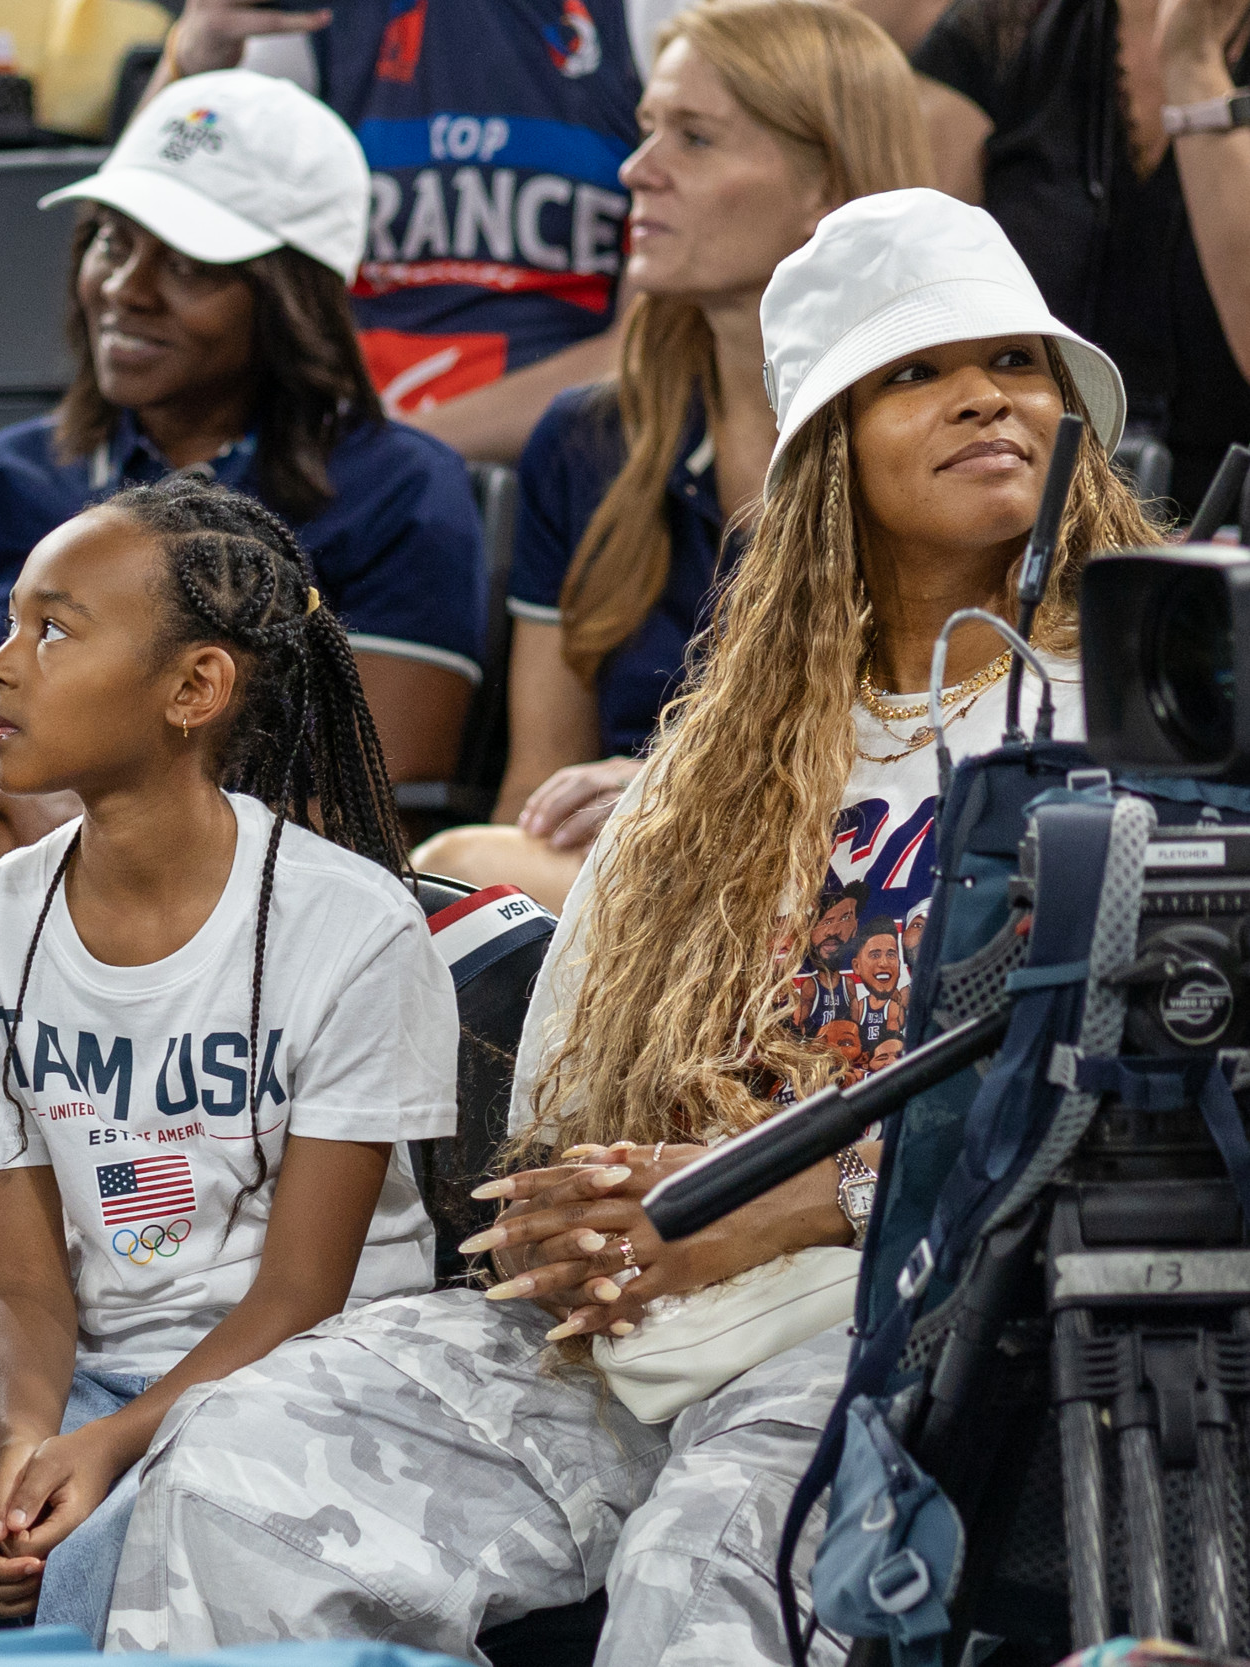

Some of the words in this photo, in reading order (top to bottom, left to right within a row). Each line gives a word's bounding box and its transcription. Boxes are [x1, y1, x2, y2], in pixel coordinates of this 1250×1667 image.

[362, 166, 628, 276] RANCE
[49, 1102, 95, 1120] UNITED
[155, 1028, 288, 1117] USA
